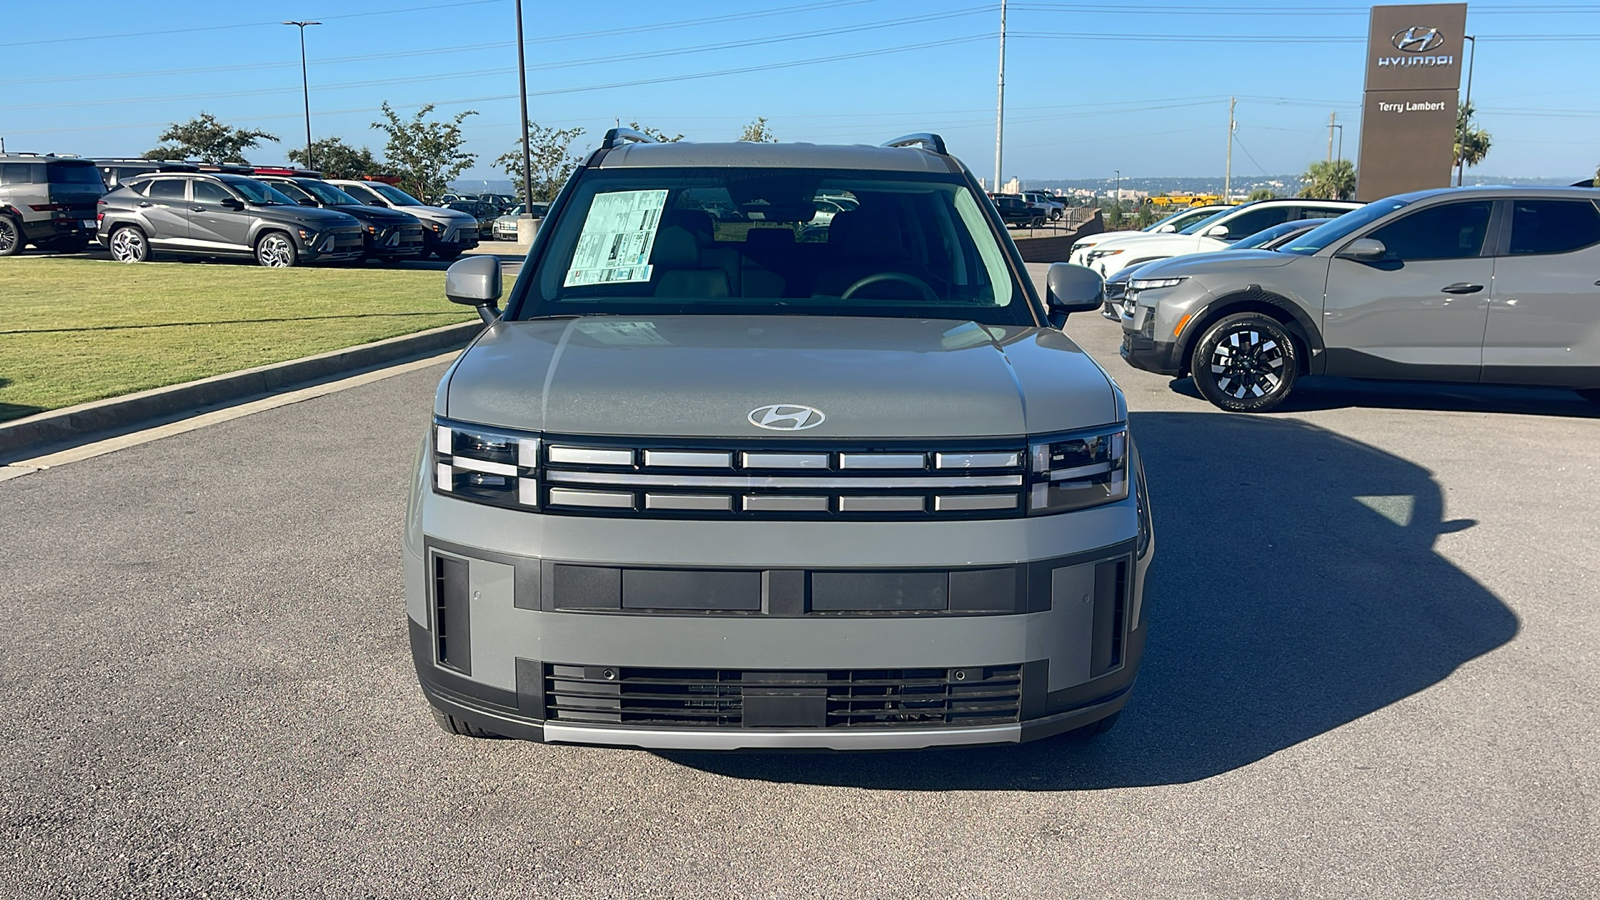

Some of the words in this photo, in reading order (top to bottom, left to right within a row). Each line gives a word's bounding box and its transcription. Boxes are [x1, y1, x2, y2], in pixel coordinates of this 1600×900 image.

[1378, 55, 1453, 67] HYUNDAI
[1379, 101, 1404, 114] Terry
[1406, 101, 1445, 111] Lambert
